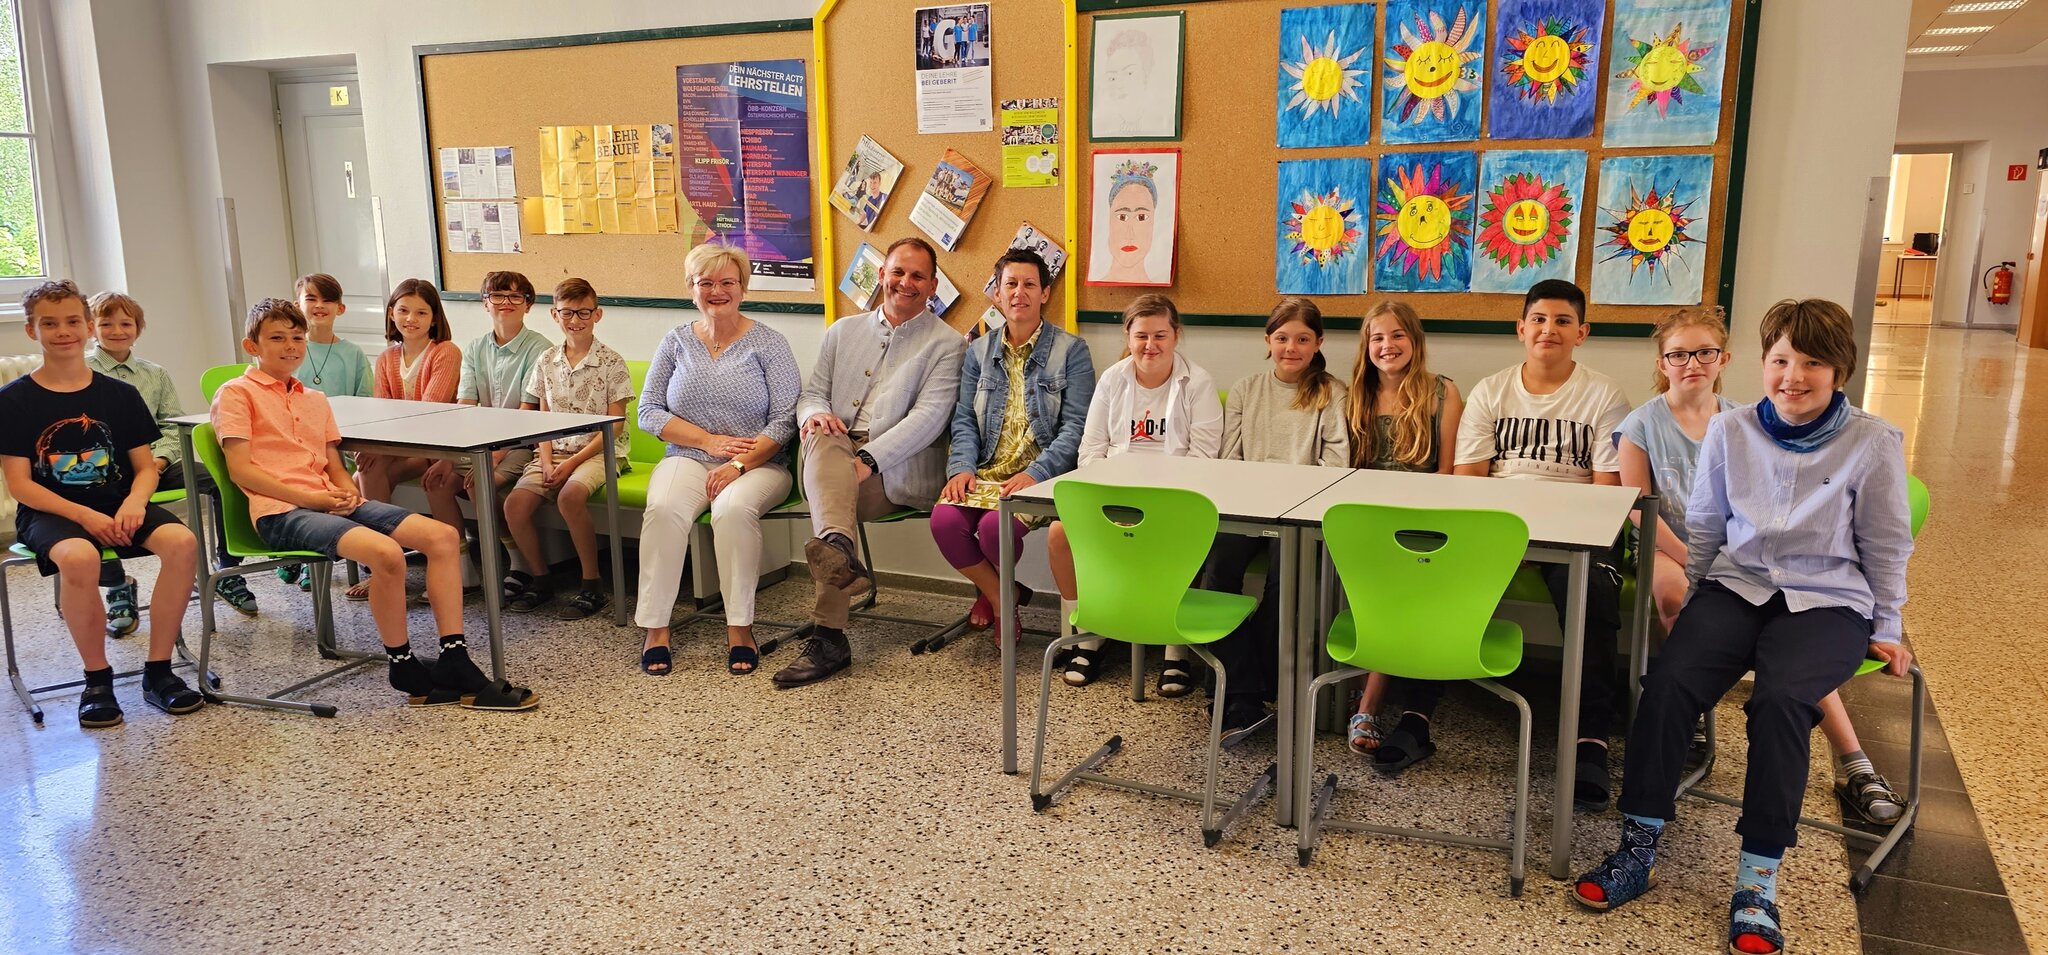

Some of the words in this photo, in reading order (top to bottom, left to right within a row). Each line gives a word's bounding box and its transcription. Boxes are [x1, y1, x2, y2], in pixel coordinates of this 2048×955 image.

[729, 65, 746, 74] DEIN
[747, 66, 784, 80] NÄCHSTER
[786, 74, 804, 84] ACT?
[728, 74, 803, 97] LEHRSTELLEN
[336, 90, 343, 102] K
[608, 128, 639, 144] LEHR
[597, 142, 640, 158] BERUFE
[752, 262, 762, 274] Z
